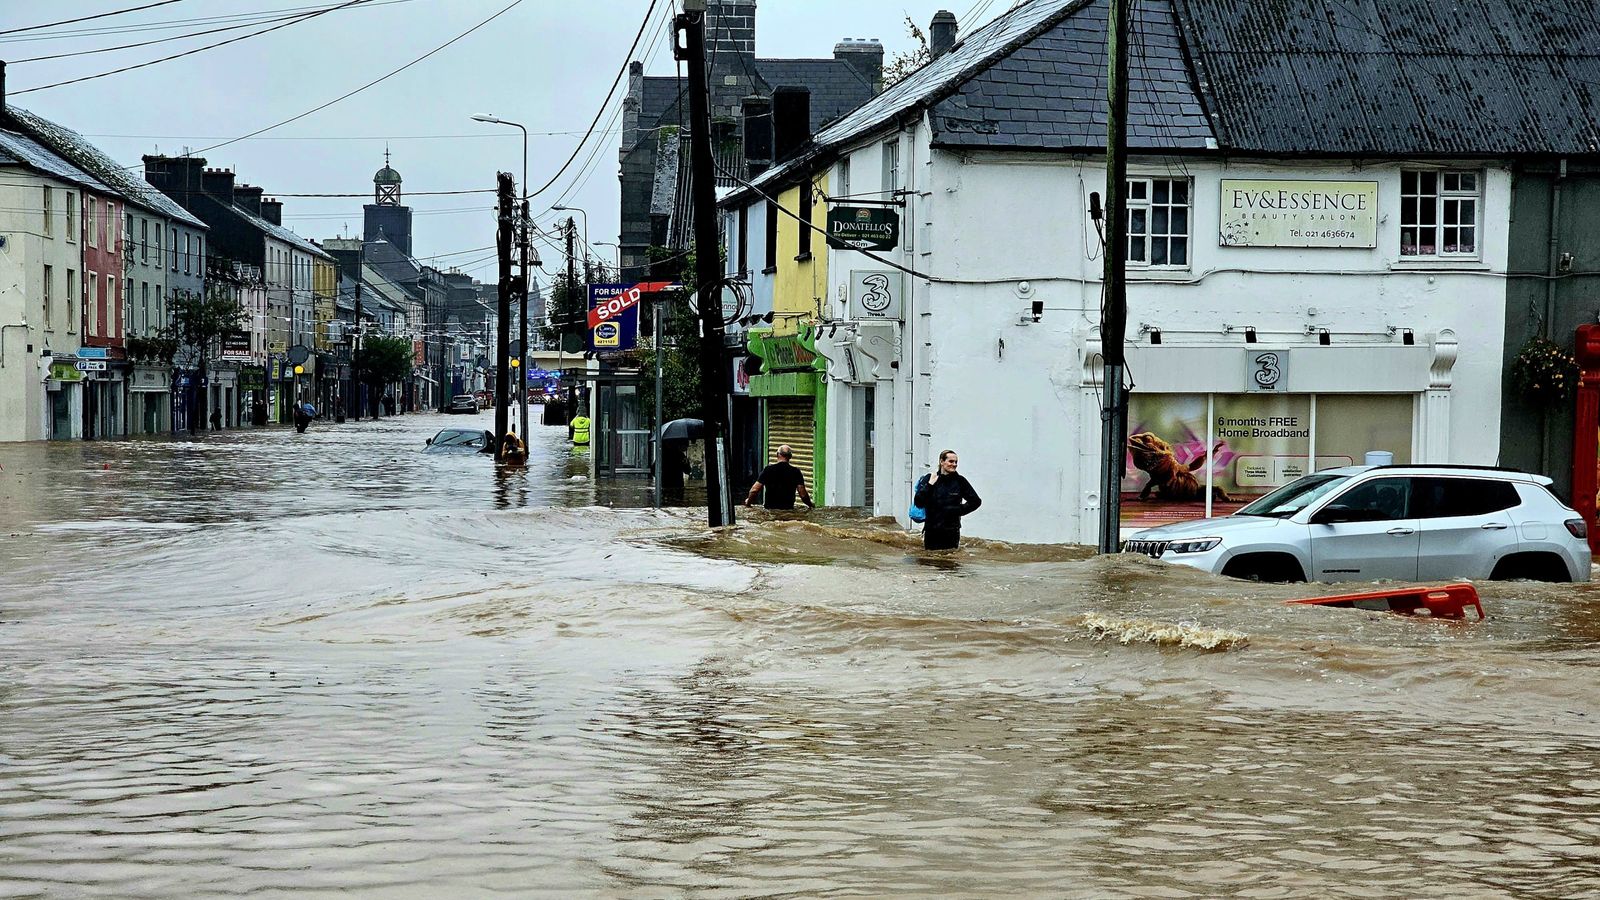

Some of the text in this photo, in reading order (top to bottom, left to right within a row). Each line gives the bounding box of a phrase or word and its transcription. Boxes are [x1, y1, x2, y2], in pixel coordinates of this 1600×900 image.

[1232, 189, 1367, 211] EV&ESSENCE
[833, 220, 892, 235] DONATELLOS
[1290, 229, 1303, 238] Tel.
[1320, 229, 1355, 239] 4636674
[597, 288, 640, 319] SOLD
[1218, 417, 1297, 426] 6 months FREE
[1218, 428, 1309, 438] Home Broadband
